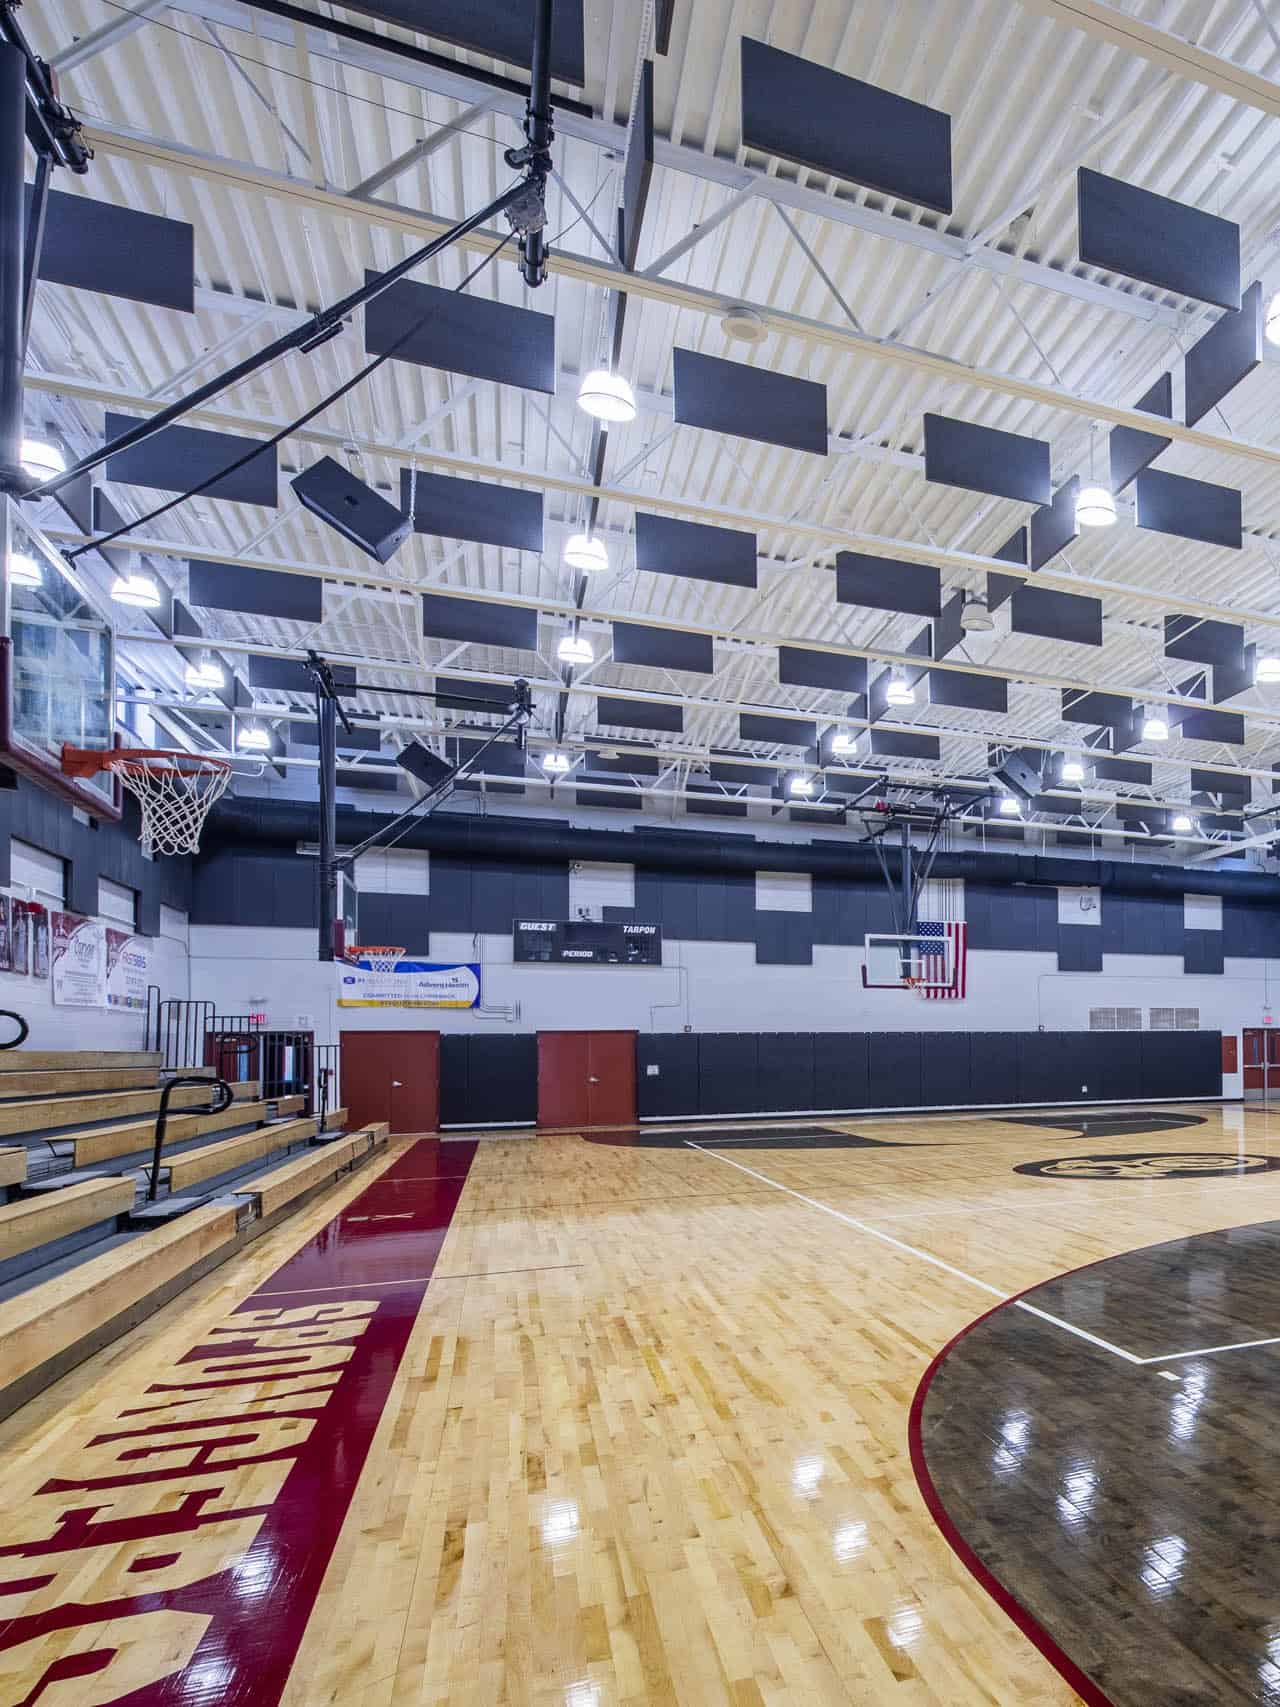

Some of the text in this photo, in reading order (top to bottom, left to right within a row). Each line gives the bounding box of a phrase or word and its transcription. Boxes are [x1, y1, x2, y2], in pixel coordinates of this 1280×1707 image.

[519, 922, 557, 931] GUEST
[623, 925, 656, 934] TARPON
[562, 950, 593, 958] PERIOD
